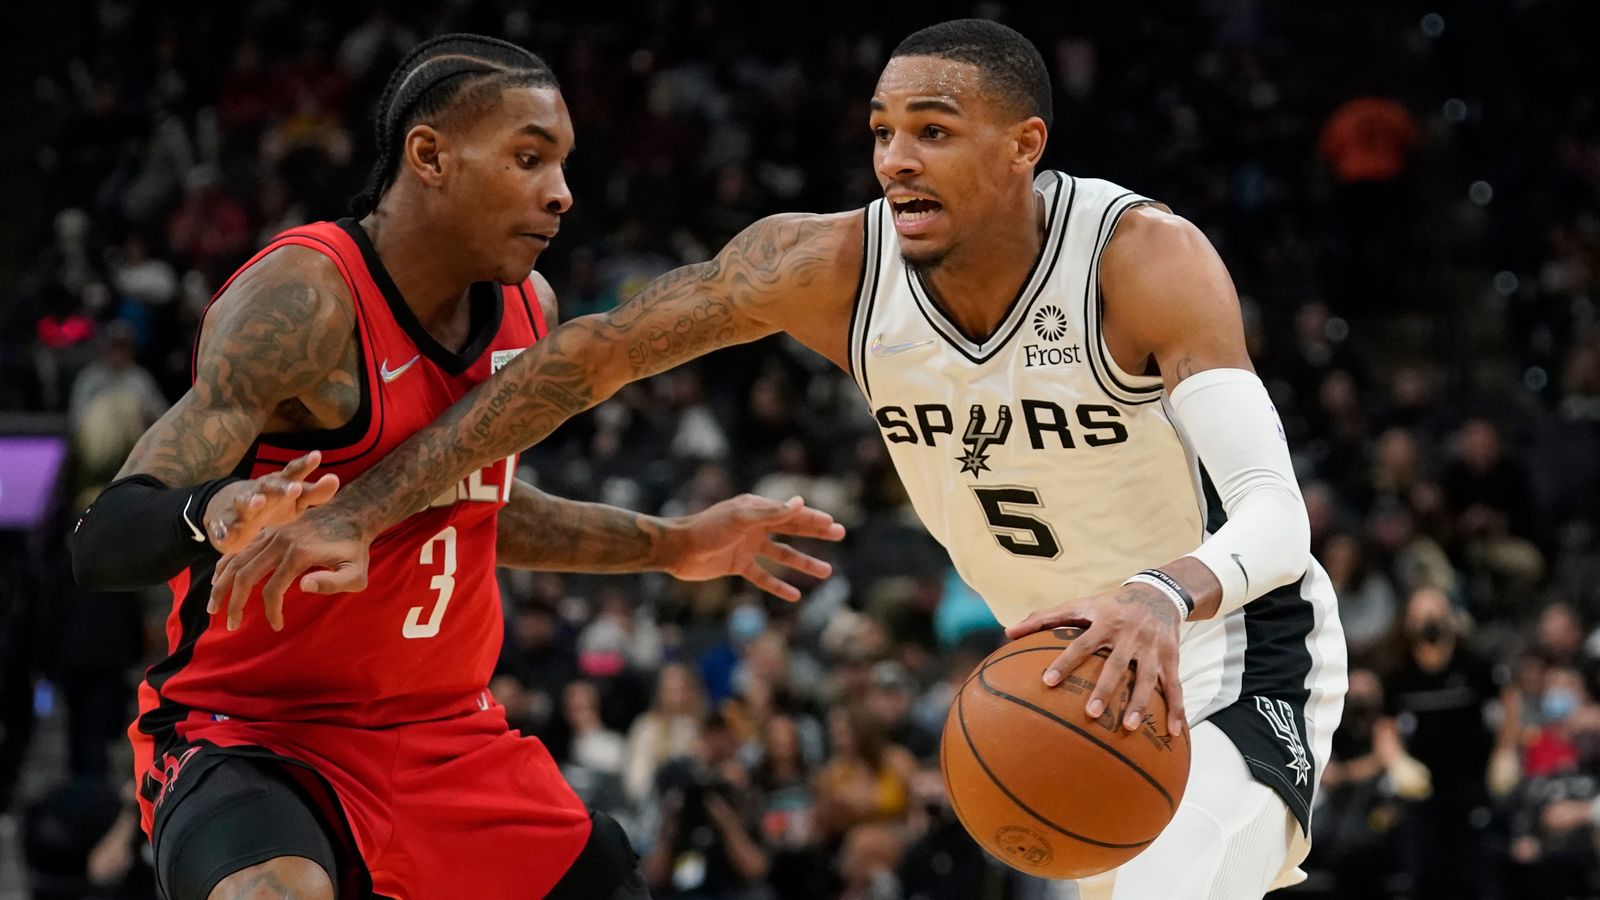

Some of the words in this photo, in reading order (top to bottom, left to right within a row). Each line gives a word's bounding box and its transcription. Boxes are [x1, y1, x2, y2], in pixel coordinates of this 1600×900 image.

[1023, 343, 1081, 367] Frost
[876, 399, 1129, 479] SPURS
[968, 484, 1064, 561] 5
[402, 526, 456, 639] 3
